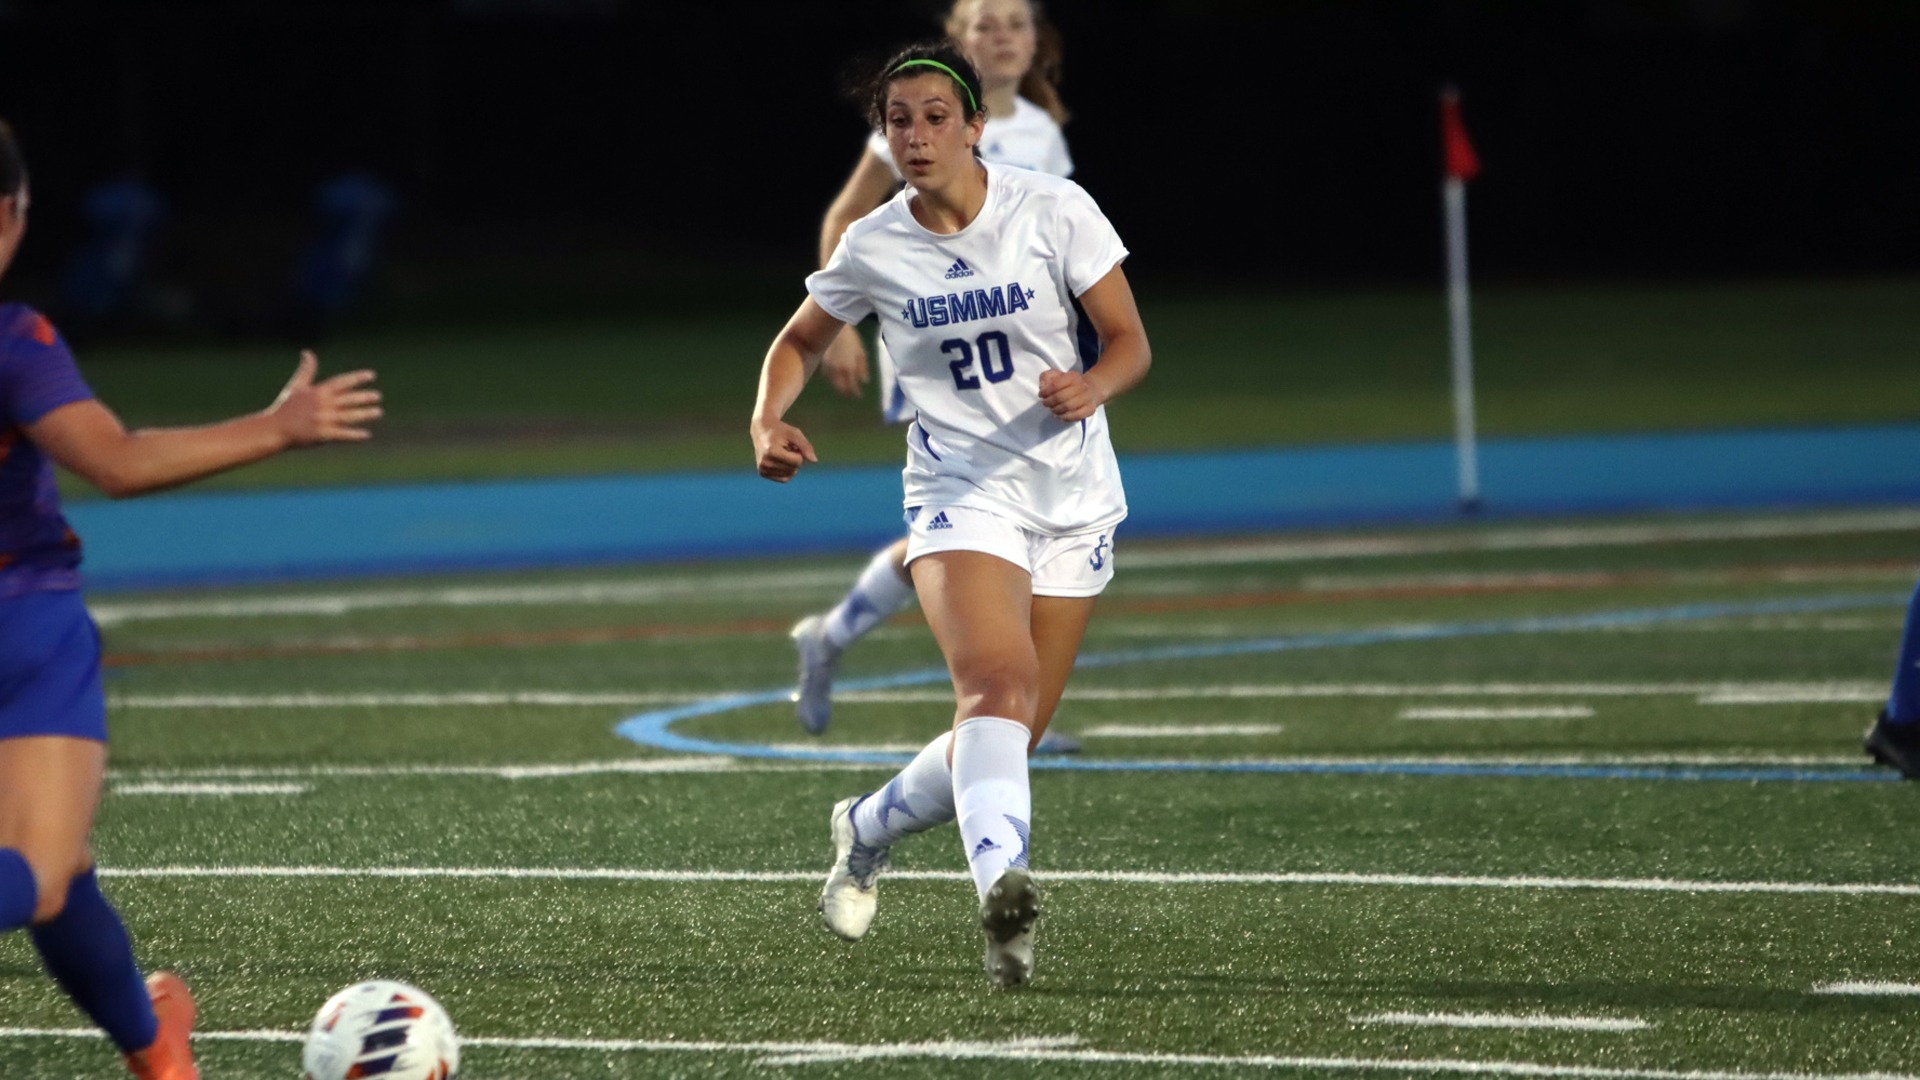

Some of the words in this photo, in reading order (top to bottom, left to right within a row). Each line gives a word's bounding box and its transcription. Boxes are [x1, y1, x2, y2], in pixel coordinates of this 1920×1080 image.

[944, 269, 975, 280] adidas
[907, 282, 1030, 329] USMMA
[940, 330, 1015, 390] 20
